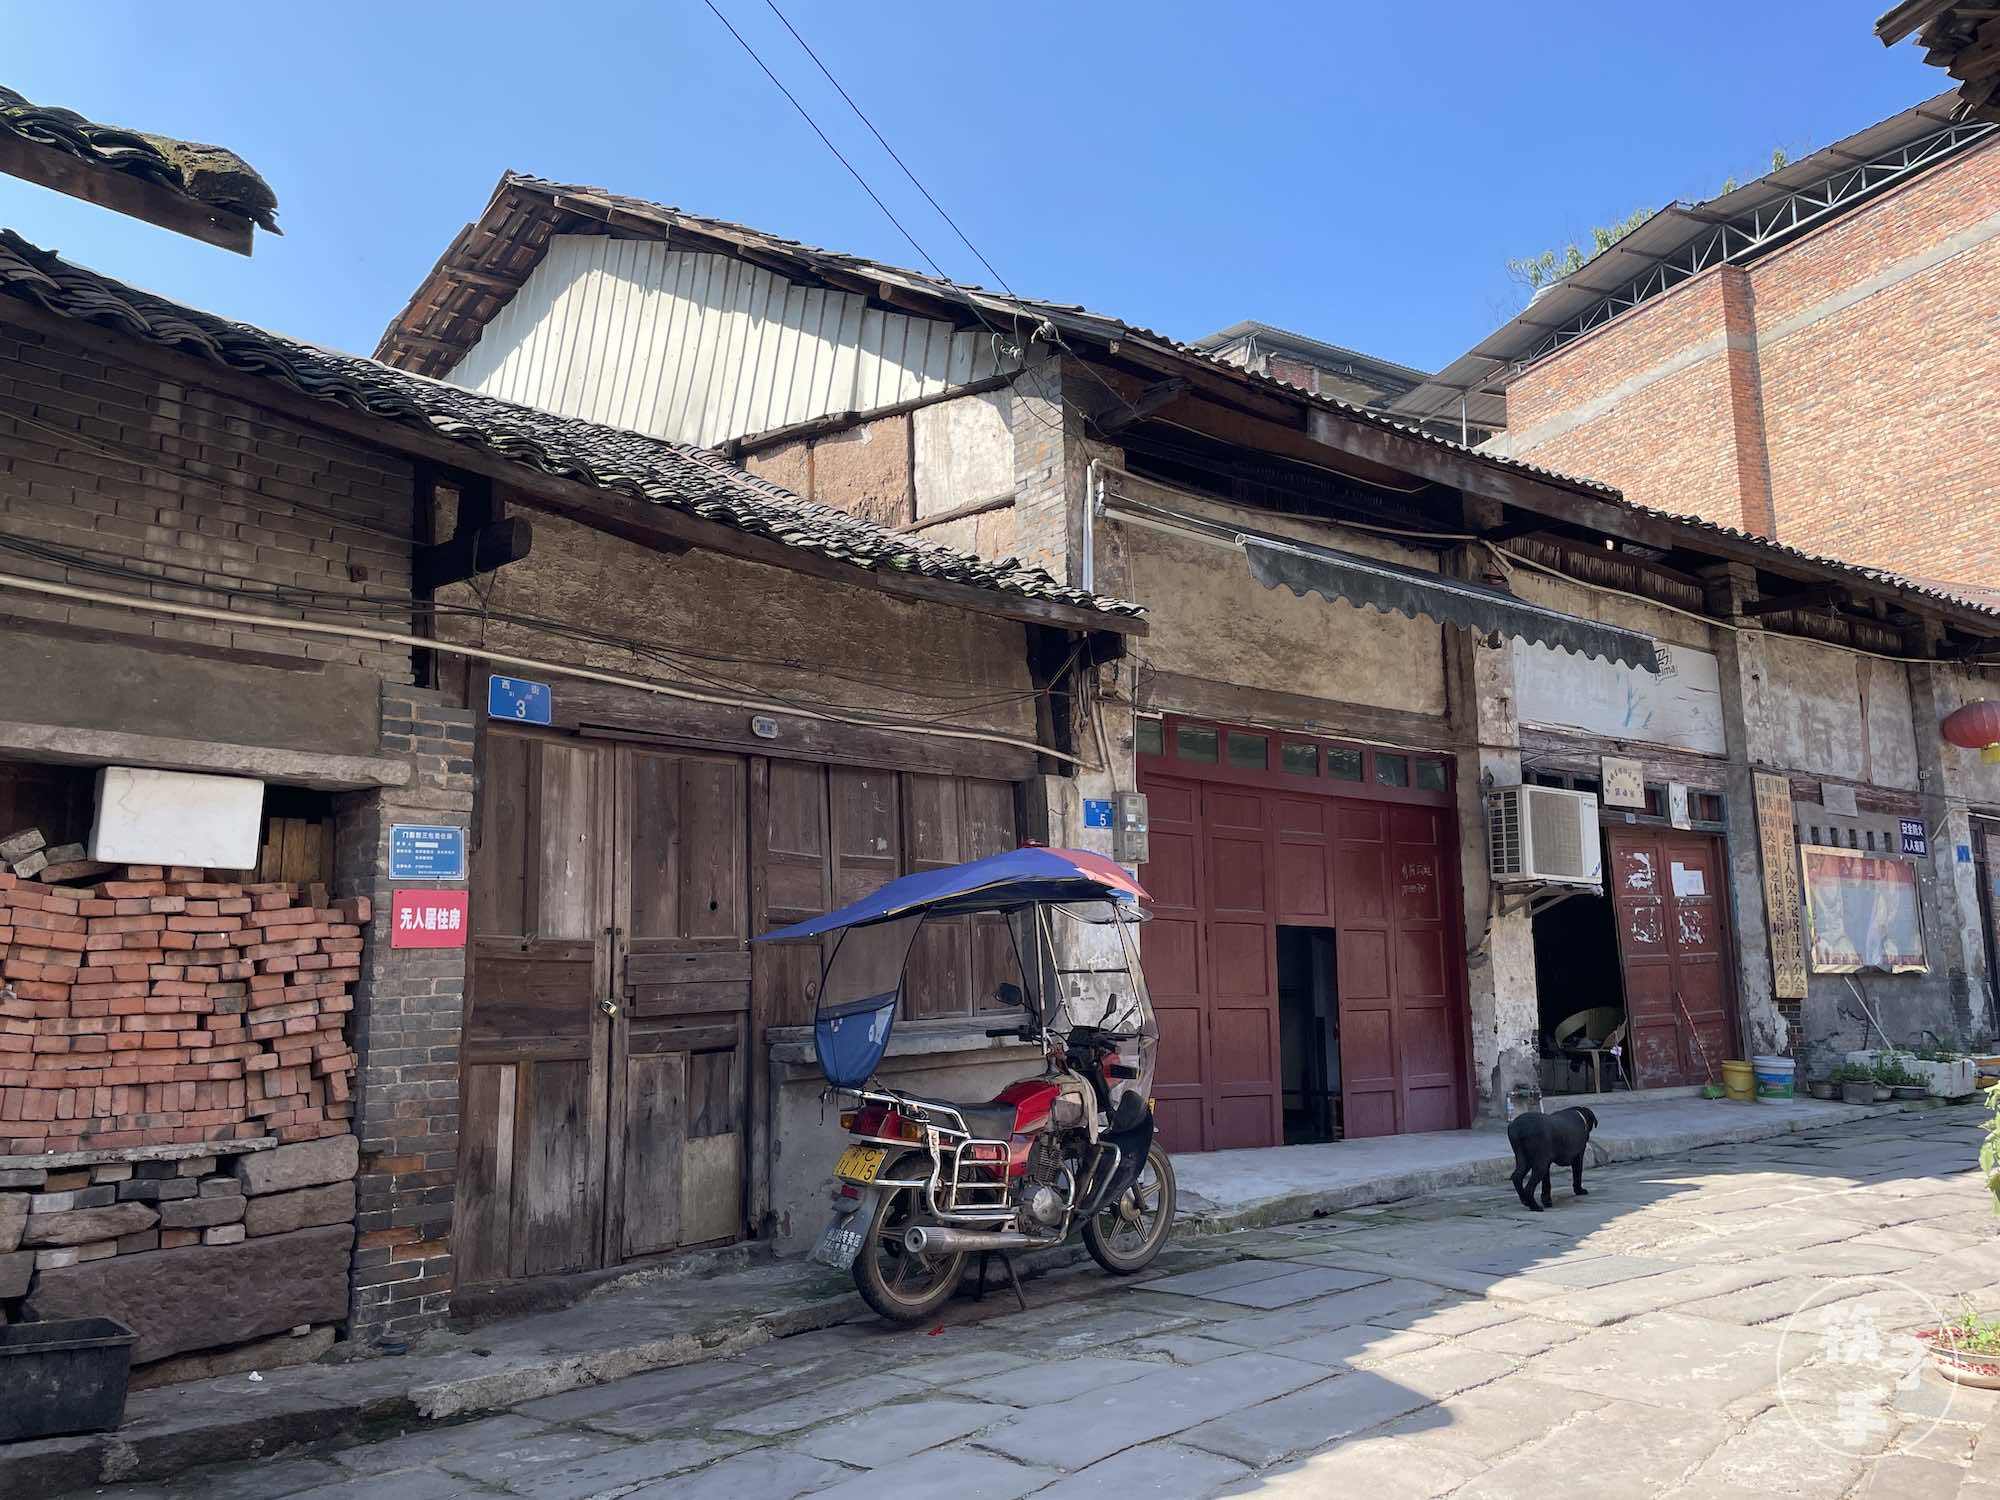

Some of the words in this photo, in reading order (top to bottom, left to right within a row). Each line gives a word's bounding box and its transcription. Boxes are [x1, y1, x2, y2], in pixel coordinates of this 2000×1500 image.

[515, 699, 526, 718] 3
[1100, 813, 1107, 826] 5
[1901, 822, 1924, 836] 安全防火
[400, 907, 461, 931] 无人居住房
